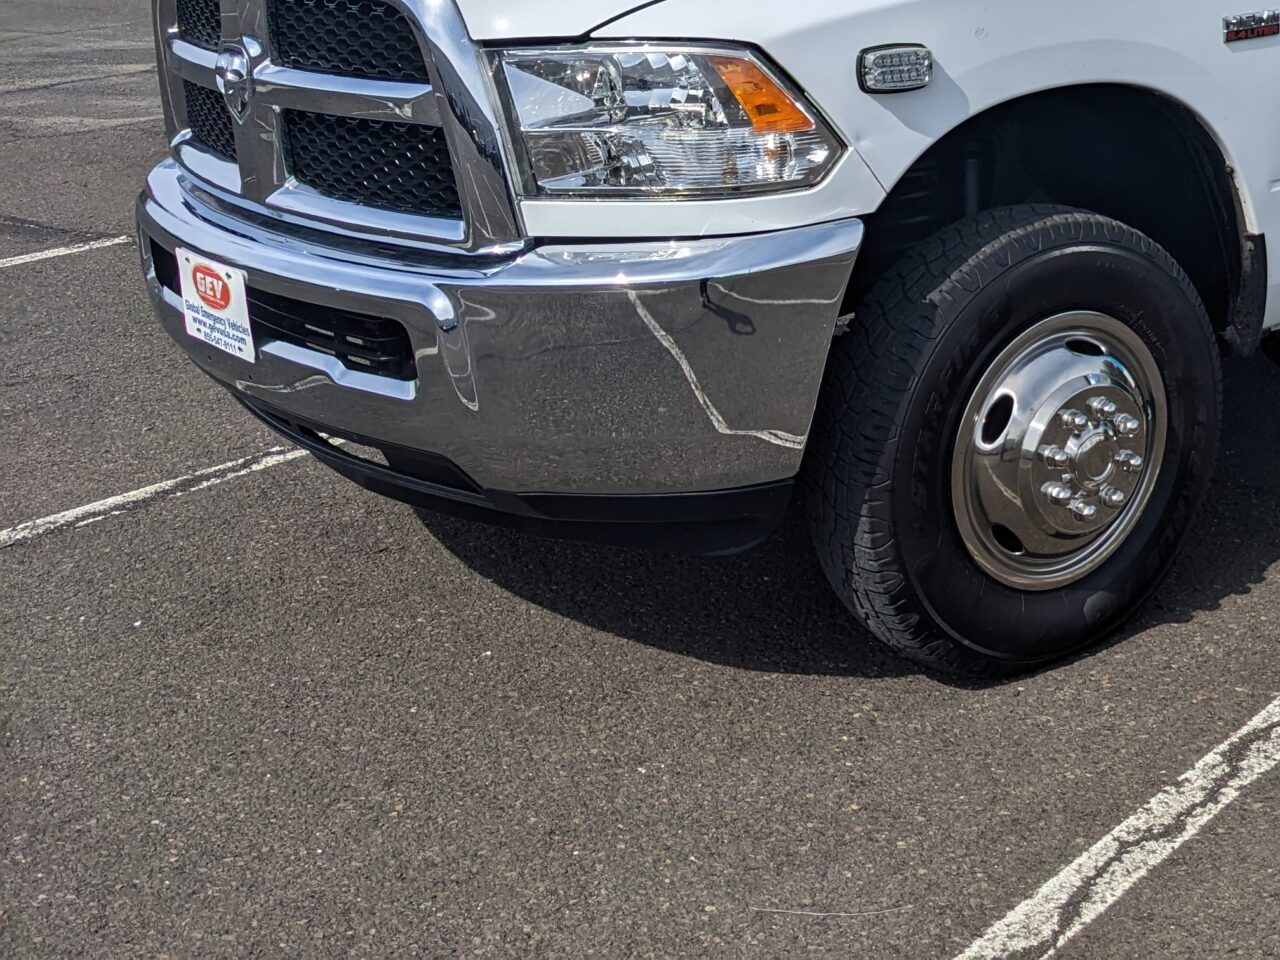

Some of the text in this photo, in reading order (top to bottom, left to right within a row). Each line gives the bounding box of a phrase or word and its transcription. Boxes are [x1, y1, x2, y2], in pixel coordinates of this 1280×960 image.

[1247, 24, 1279, 38] LITER
[196, 271, 223, 299] GEV
[184, 299, 250, 337] Global Emergency Vehicles
[192, 315, 247, 346] www.gevusa.com
